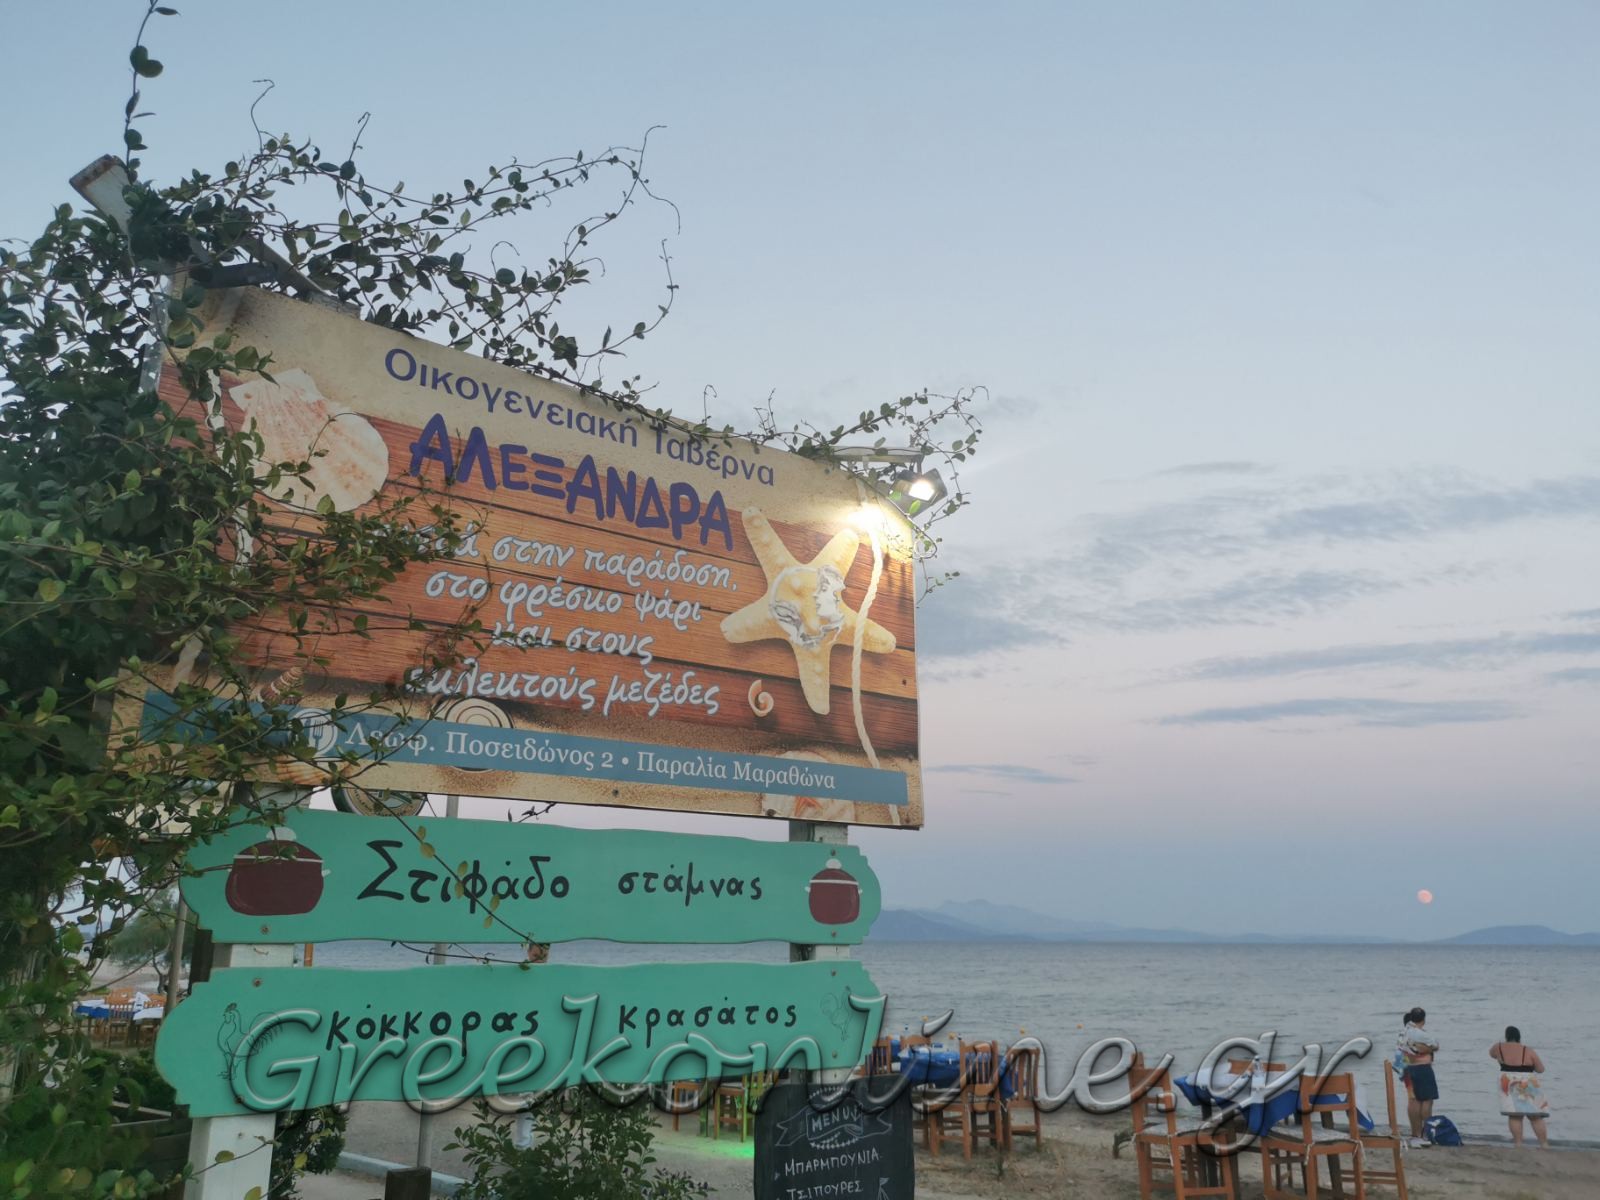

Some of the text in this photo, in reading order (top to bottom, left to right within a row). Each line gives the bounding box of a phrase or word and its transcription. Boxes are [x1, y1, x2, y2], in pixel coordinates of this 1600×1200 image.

[384, 348, 638, 448] Οικογενειακή
[408, 412, 734, 552] ΑΛΕΞΑΝΔΡΑ
[492, 535, 576, 568] στην
[584, 547, 738, 592] παράδοση,
[425, 571, 702, 632] στο φρέσκο ψάρι
[491, 621, 655, 666] και στους
[602, 666, 722, 718] μεζέδες
[445, 731, 596, 771] Ποσειδώνος
[601, 751, 615, 769] 2
[636, 751, 728, 780] Παραλία
[732, 760, 836, 790] Μαραθώνα
[357, 839, 763, 914] Στιφάδο στάμνας
[325, 996, 798, 1058] κόκκορας κρασάτος
[784, 1146, 880, 1177] ΜΠΑΡΜΠΟΥΝΙΑ
